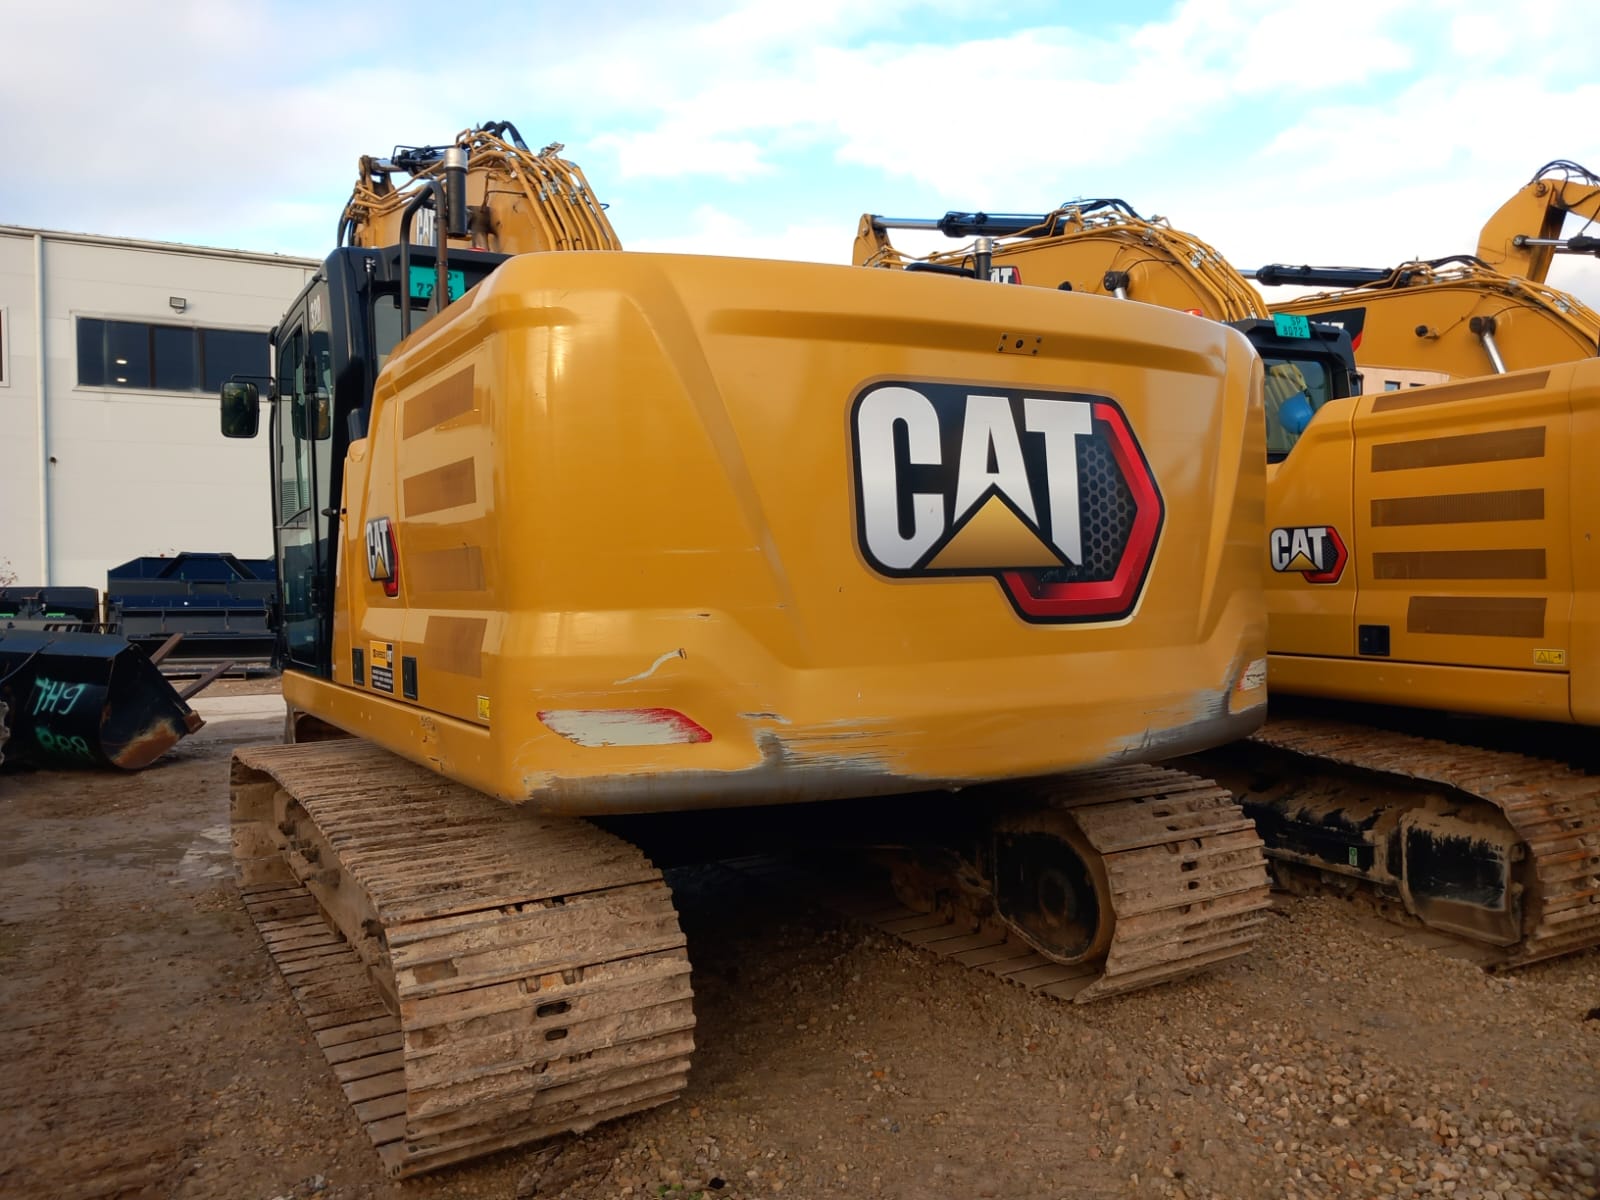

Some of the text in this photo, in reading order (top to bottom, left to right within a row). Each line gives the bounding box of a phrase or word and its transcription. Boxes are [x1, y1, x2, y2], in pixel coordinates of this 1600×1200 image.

[857, 386, 1092, 570] CAT
[366, 518, 391, 580] CAT
[1270, 527, 1326, 570] CAT
